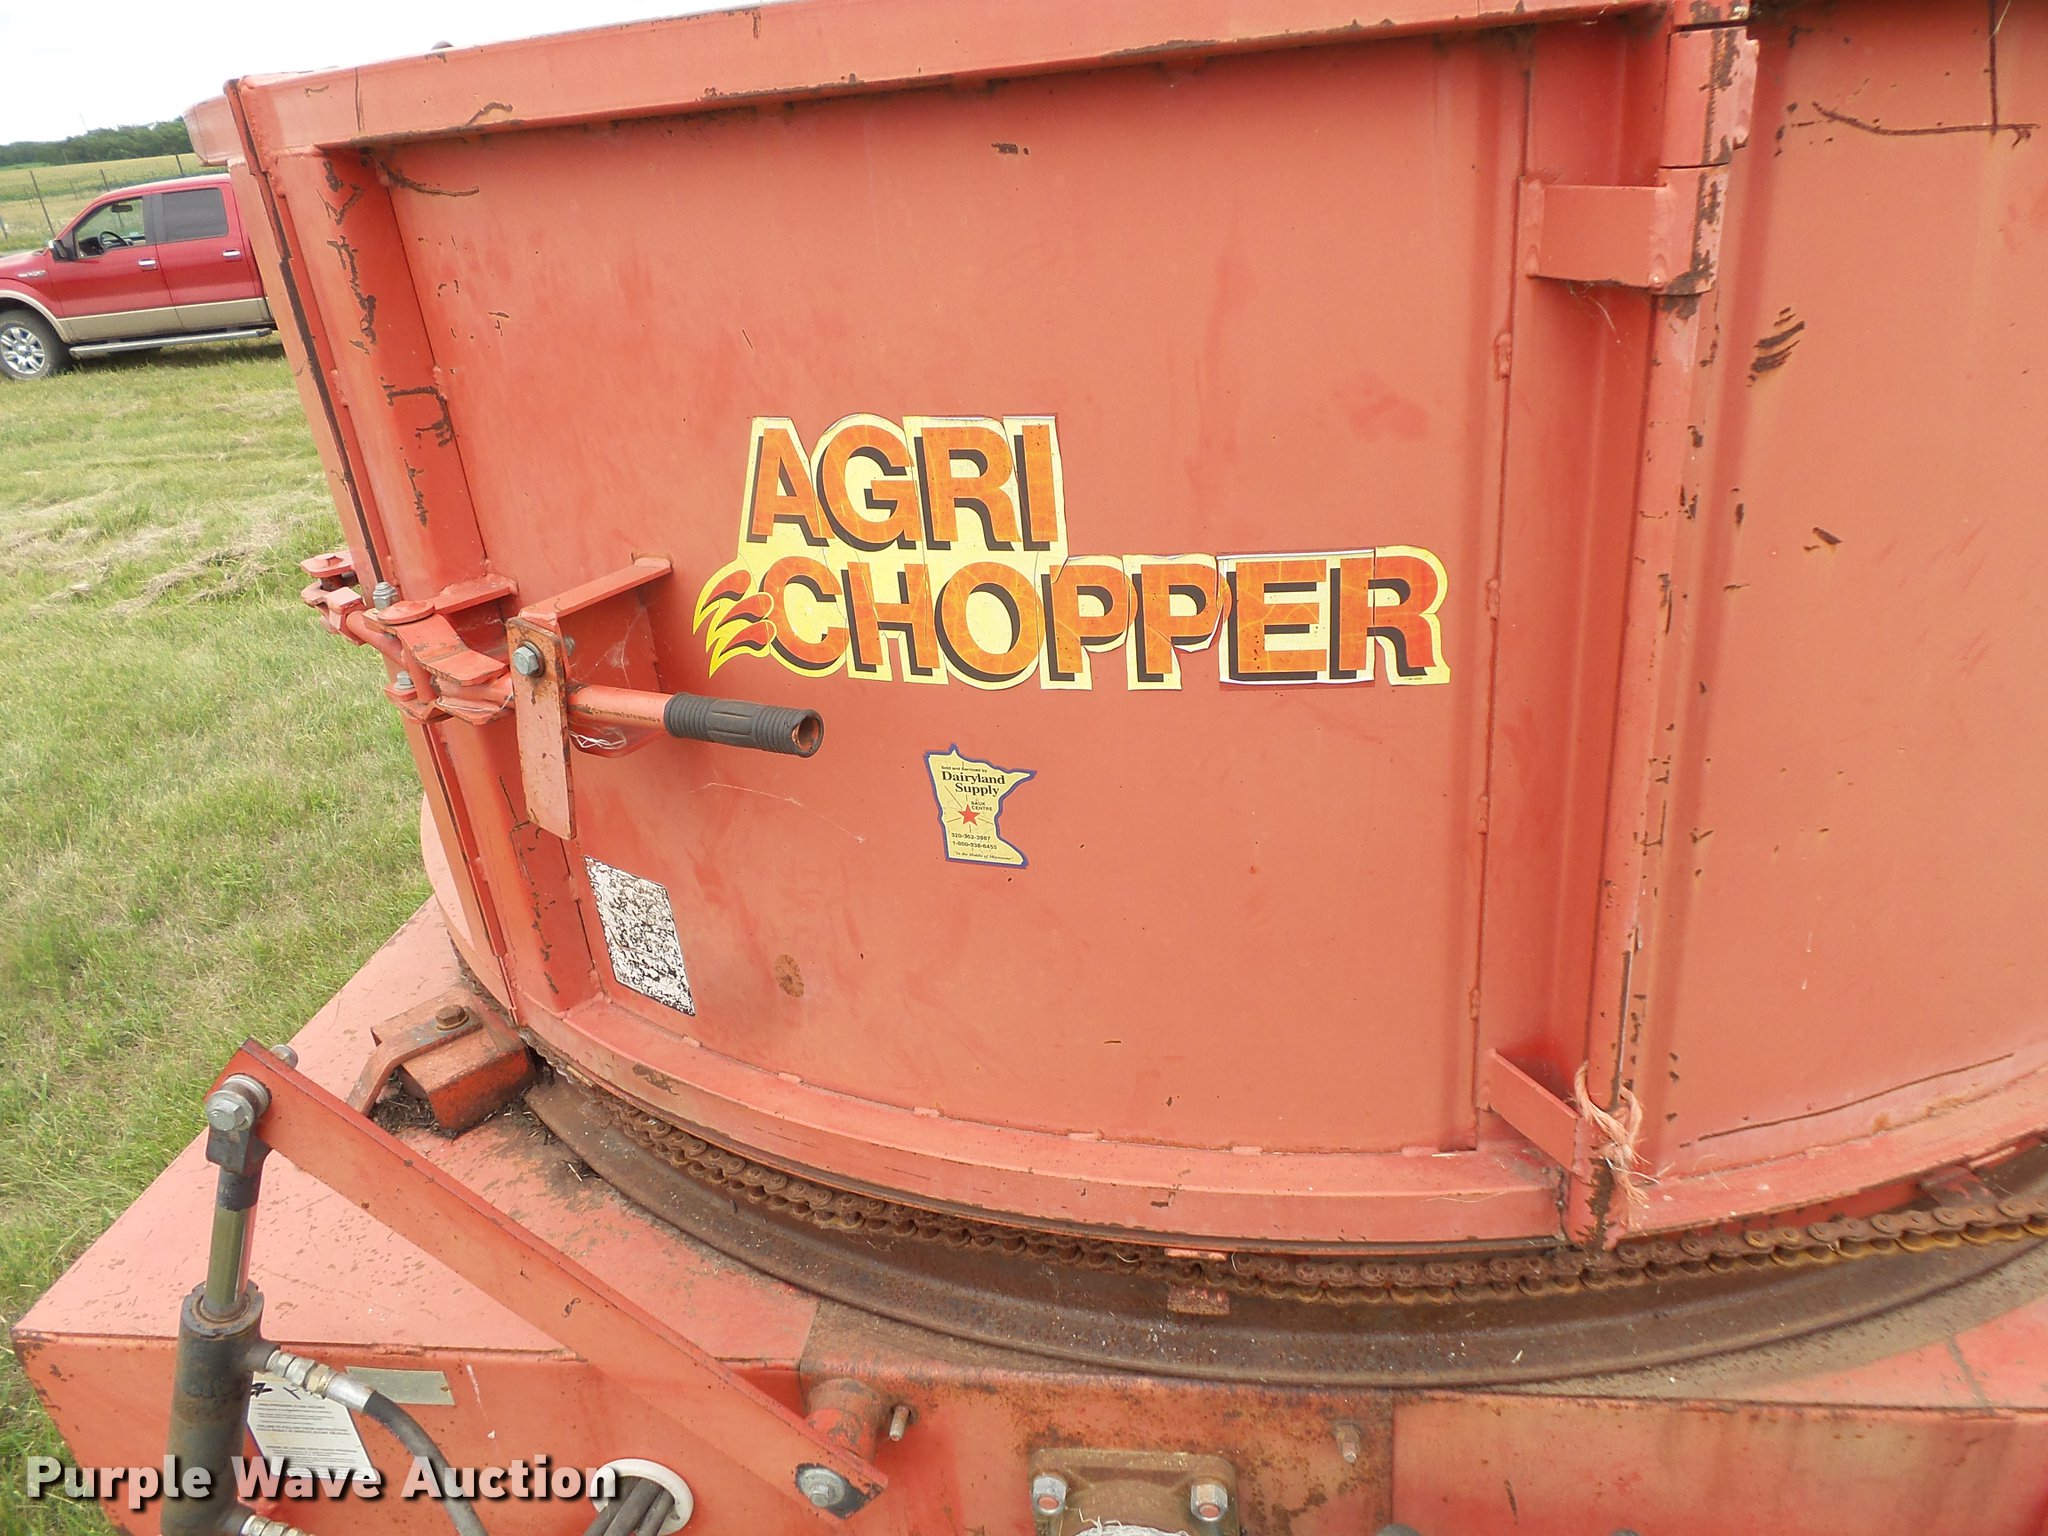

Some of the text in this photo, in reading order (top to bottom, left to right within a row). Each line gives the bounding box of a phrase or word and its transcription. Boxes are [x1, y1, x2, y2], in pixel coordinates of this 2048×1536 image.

[746, 424, 1059, 552] AGRI
[758, 555, 1439, 682] CHOPPER
[942, 771, 1005, 785] Dairyland
[955, 782, 1000, 797] Supply
